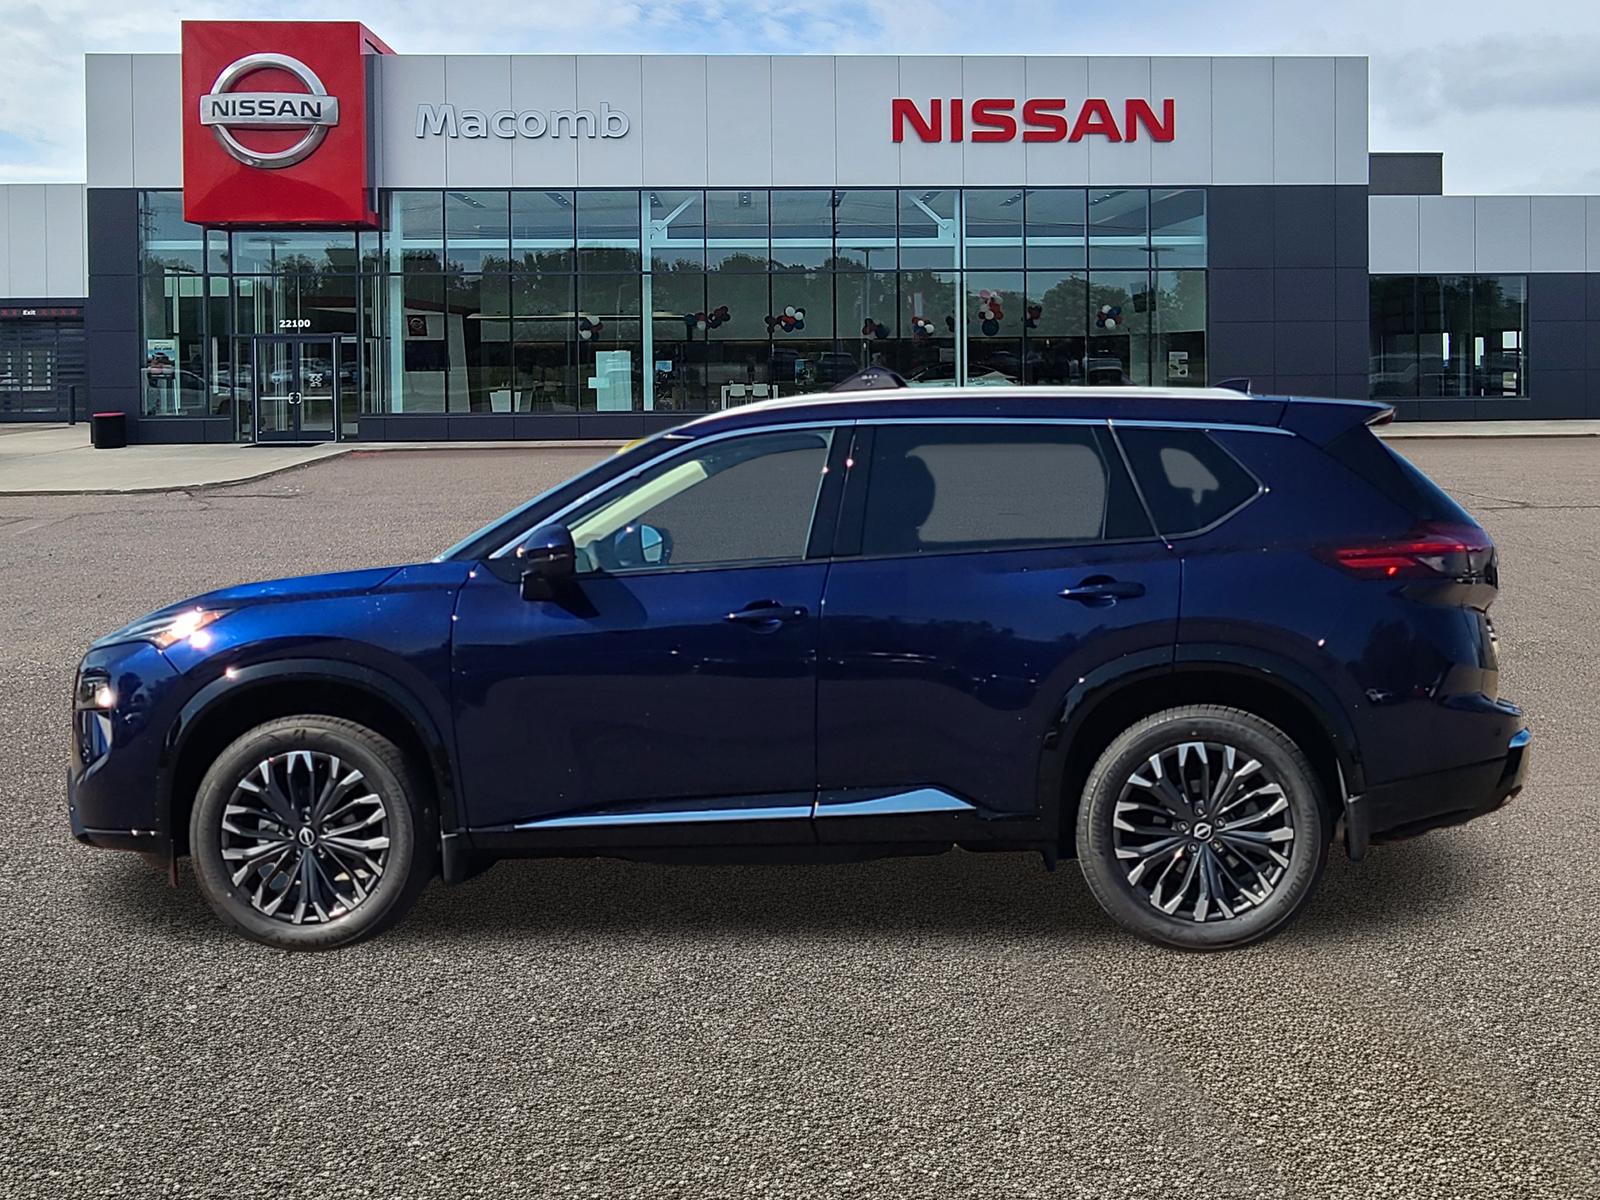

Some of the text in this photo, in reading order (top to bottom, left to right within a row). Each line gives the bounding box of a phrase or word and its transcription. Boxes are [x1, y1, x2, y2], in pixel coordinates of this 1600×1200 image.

[212, 100, 321, 117] NISSAN
[415, 102, 630, 138] Macomb
[892, 98, 1175, 143] NISSAN
[280, 319, 311, 328] 22100
